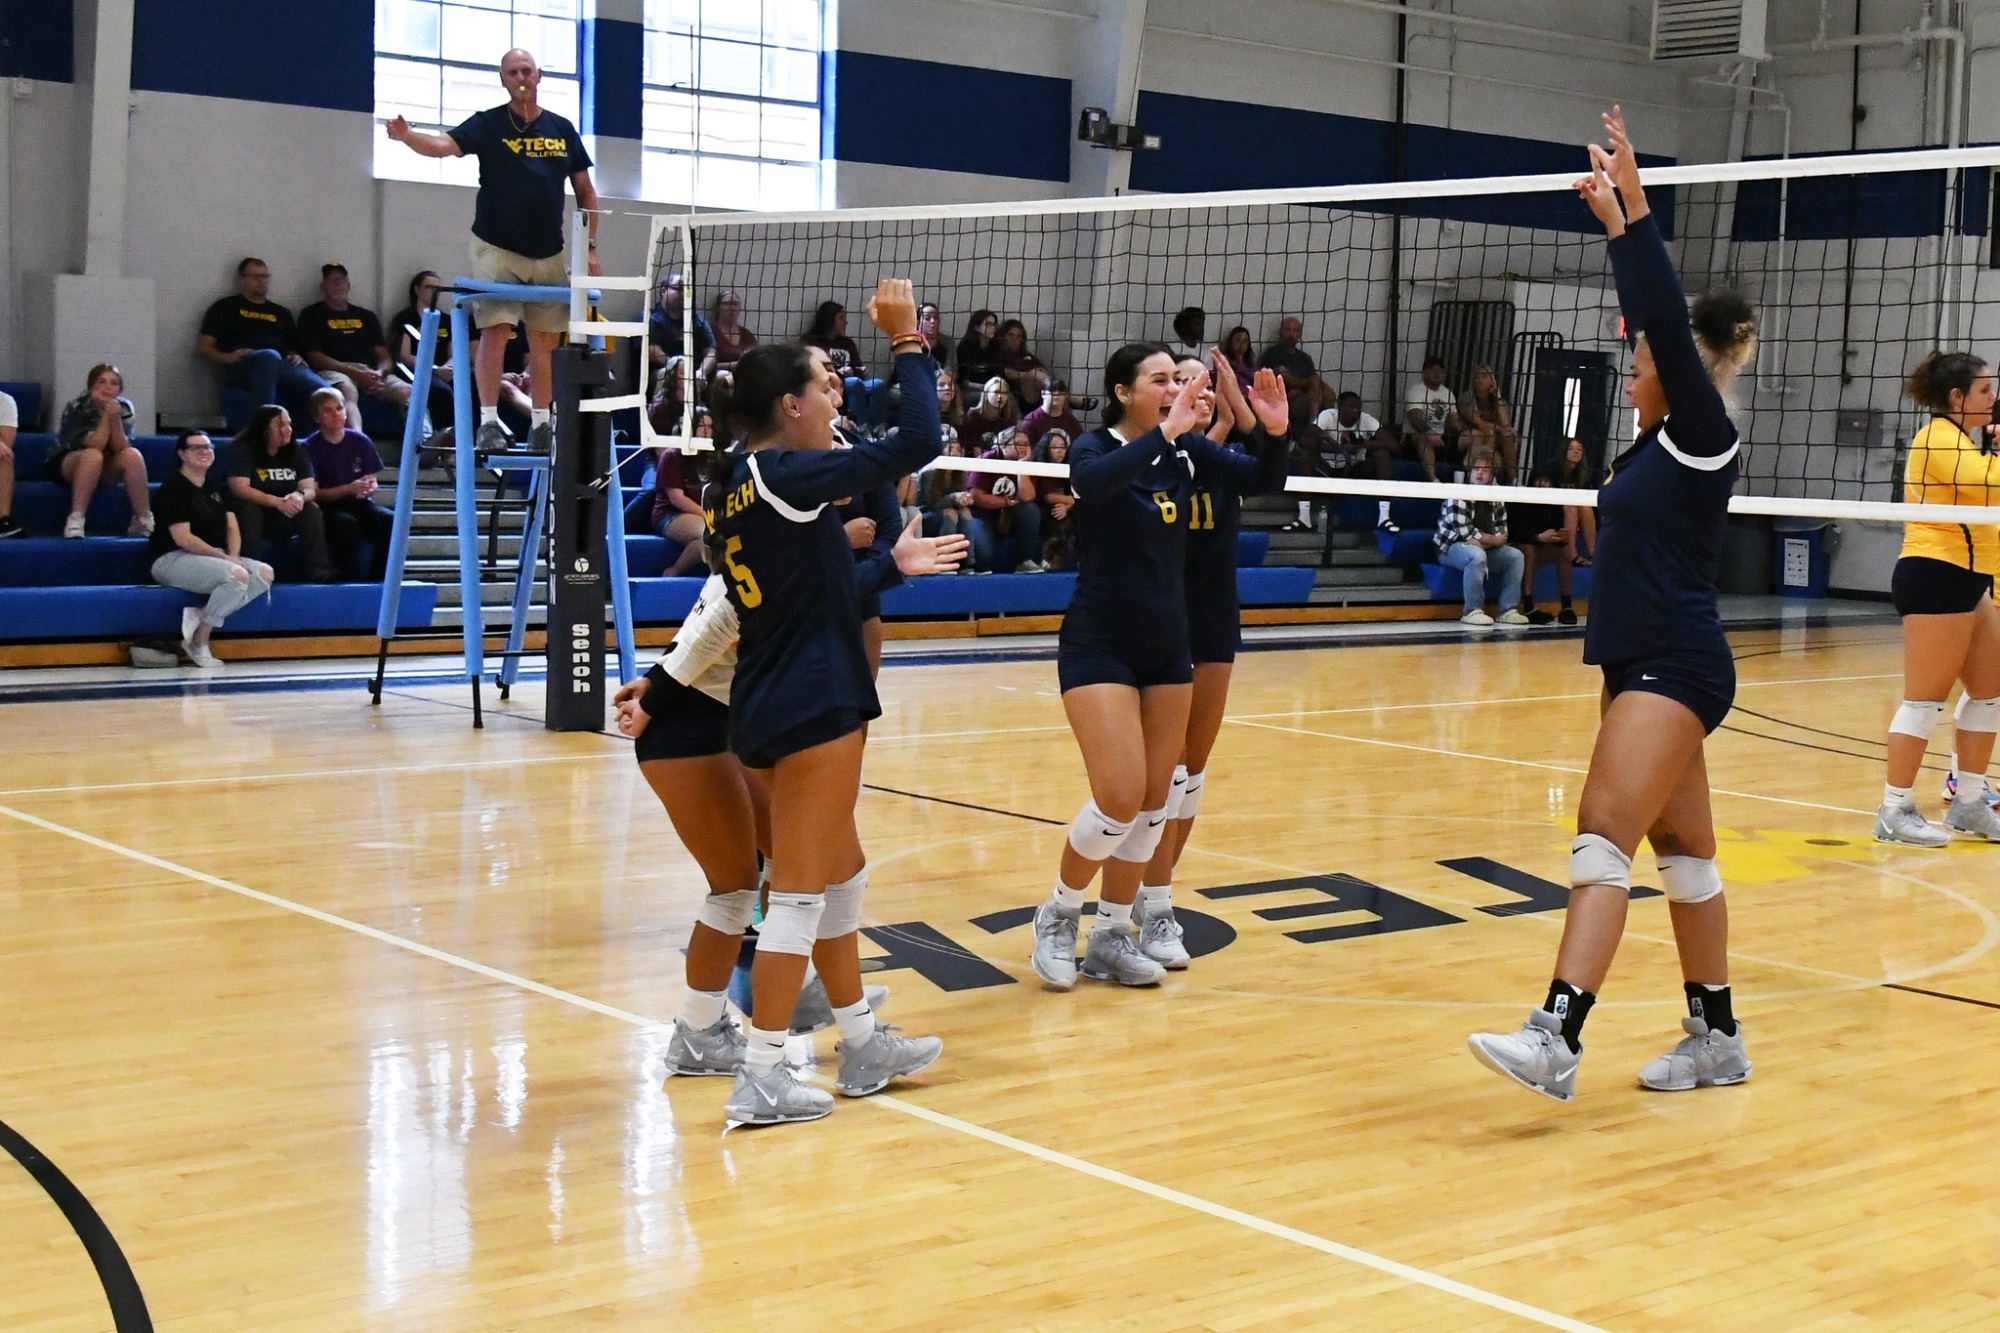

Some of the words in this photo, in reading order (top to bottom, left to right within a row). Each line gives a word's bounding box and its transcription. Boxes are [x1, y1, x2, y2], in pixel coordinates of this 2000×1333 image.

[523, 137, 566, 151] TECH
[726, 479, 755, 519] ECH
[1152, 491, 1177, 524] 6
[1189, 493, 1214, 529] 11
[725, 534, 762, 609] 5
[572, 623, 591, 693] Senoh
